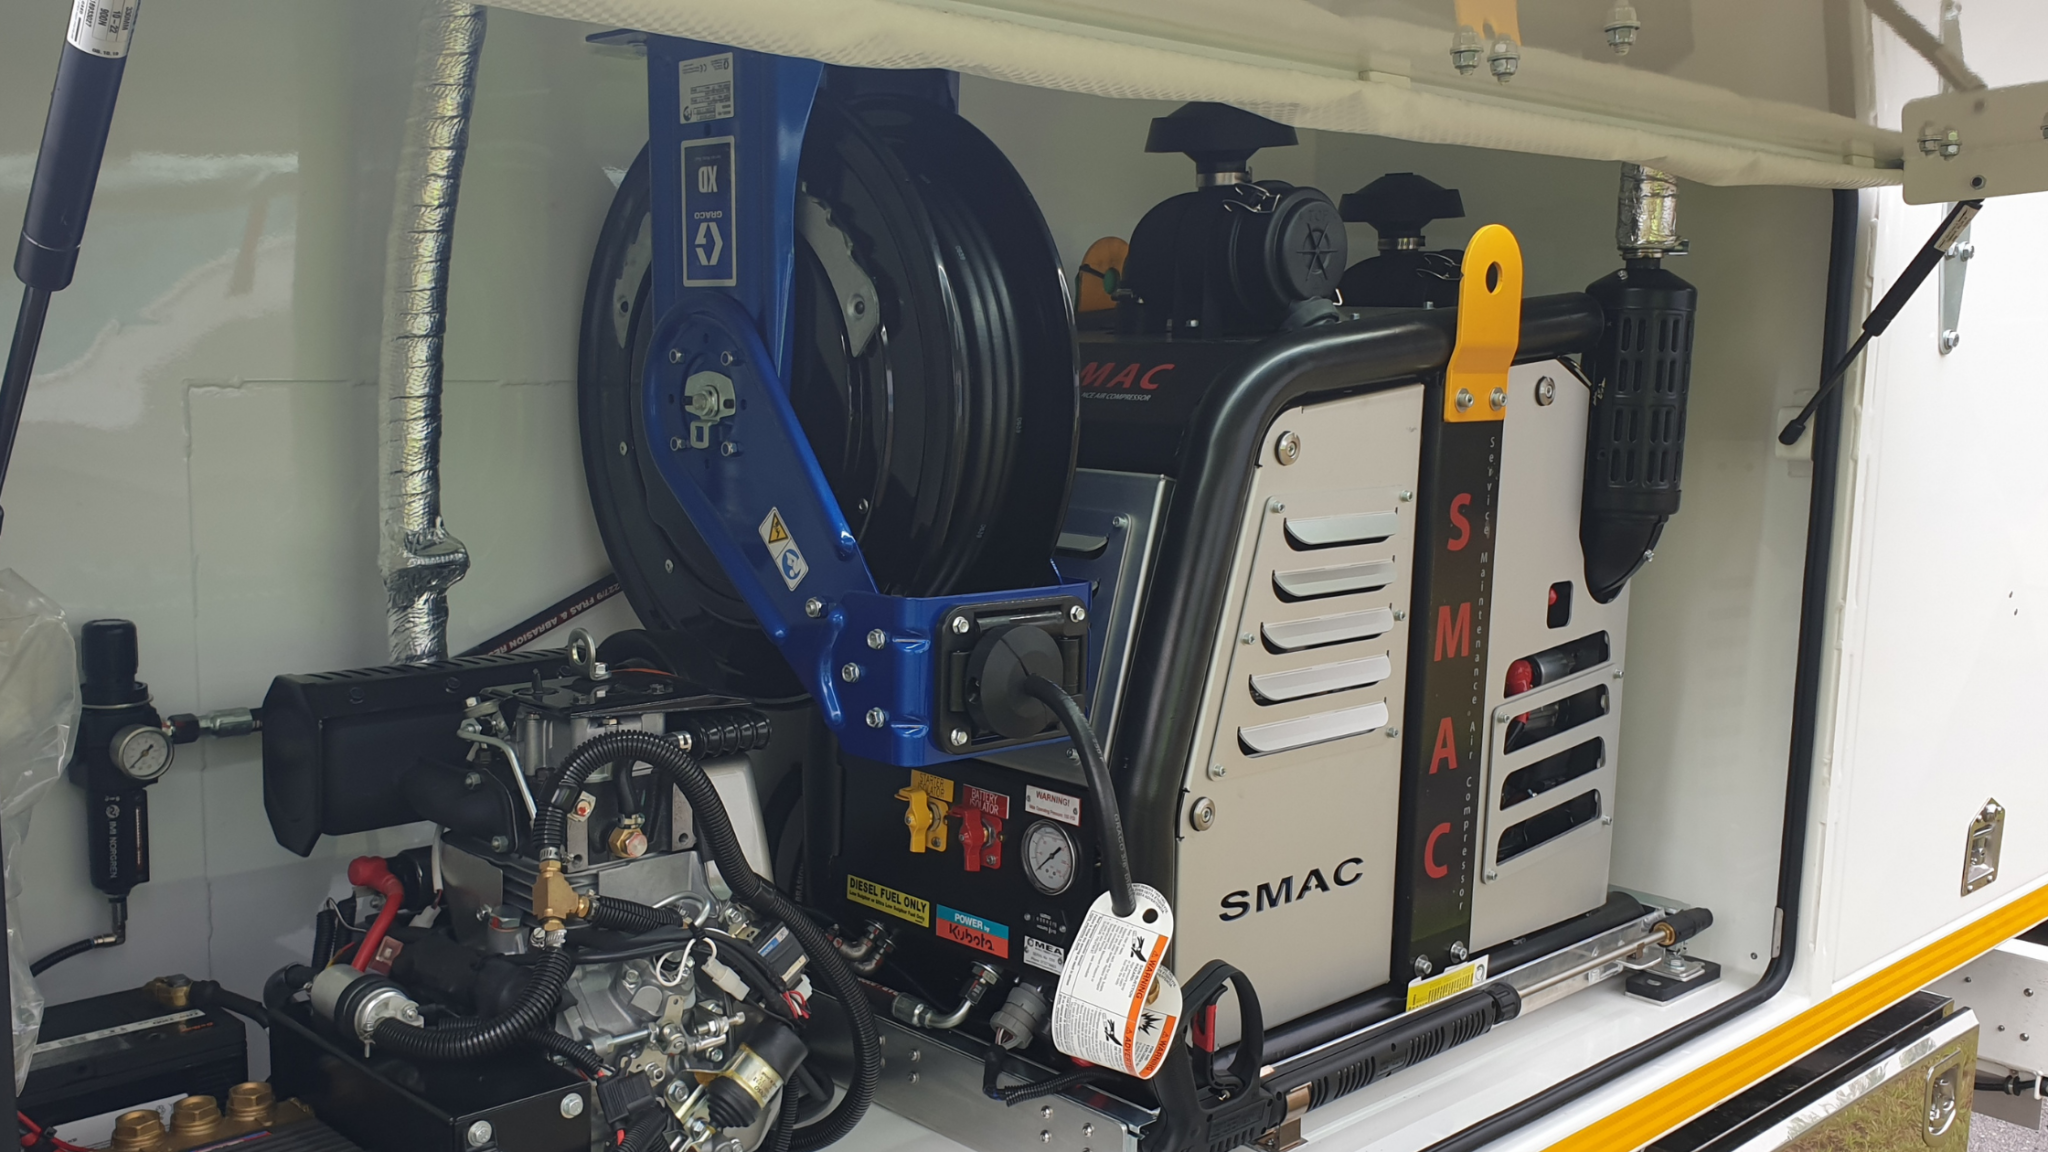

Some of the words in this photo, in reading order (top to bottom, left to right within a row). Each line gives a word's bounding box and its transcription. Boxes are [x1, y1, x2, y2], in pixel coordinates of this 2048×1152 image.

[698, 165, 718, 193] XD
[694, 210, 722, 219] GRACO
[1106, 393, 1151, 401] COMPRESSOR
[1482, 435, 1498, 537] Service
[560, 611, 568, 619] &
[570, 596, 594, 615] FRAS
[509, 617, 558, 648] ABRASION
[1470, 551, 1489, 706] Maintenance
[1468, 720, 1476, 762] Air
[919, 773, 945, 788] STARTER
[972, 788, 998, 804] BATTERY
[1036, 791, 1070, 807] WARNING!
[109, 821, 117, 836] IMI
[1114, 813, 1124, 850] GRACO
[1457, 774, 1473, 911] Compressor
[109, 836, 117, 878] NORGREN
[850, 878, 878, 896] DIESEL
[880, 888, 902, 904] FUEL
[904, 897, 927, 913] ONLY
[1219, 857, 1364, 922] SMAC
[955, 913, 983, 929] POWER
[949, 923, 994, 951] Kubota
[1035, 941, 1062, 955] MEA
[1128, 975, 1139, 998] INJECTION
[1135, 960, 1156, 1000] WARNING
[1146, 1041, 1167, 1072] WARNING
